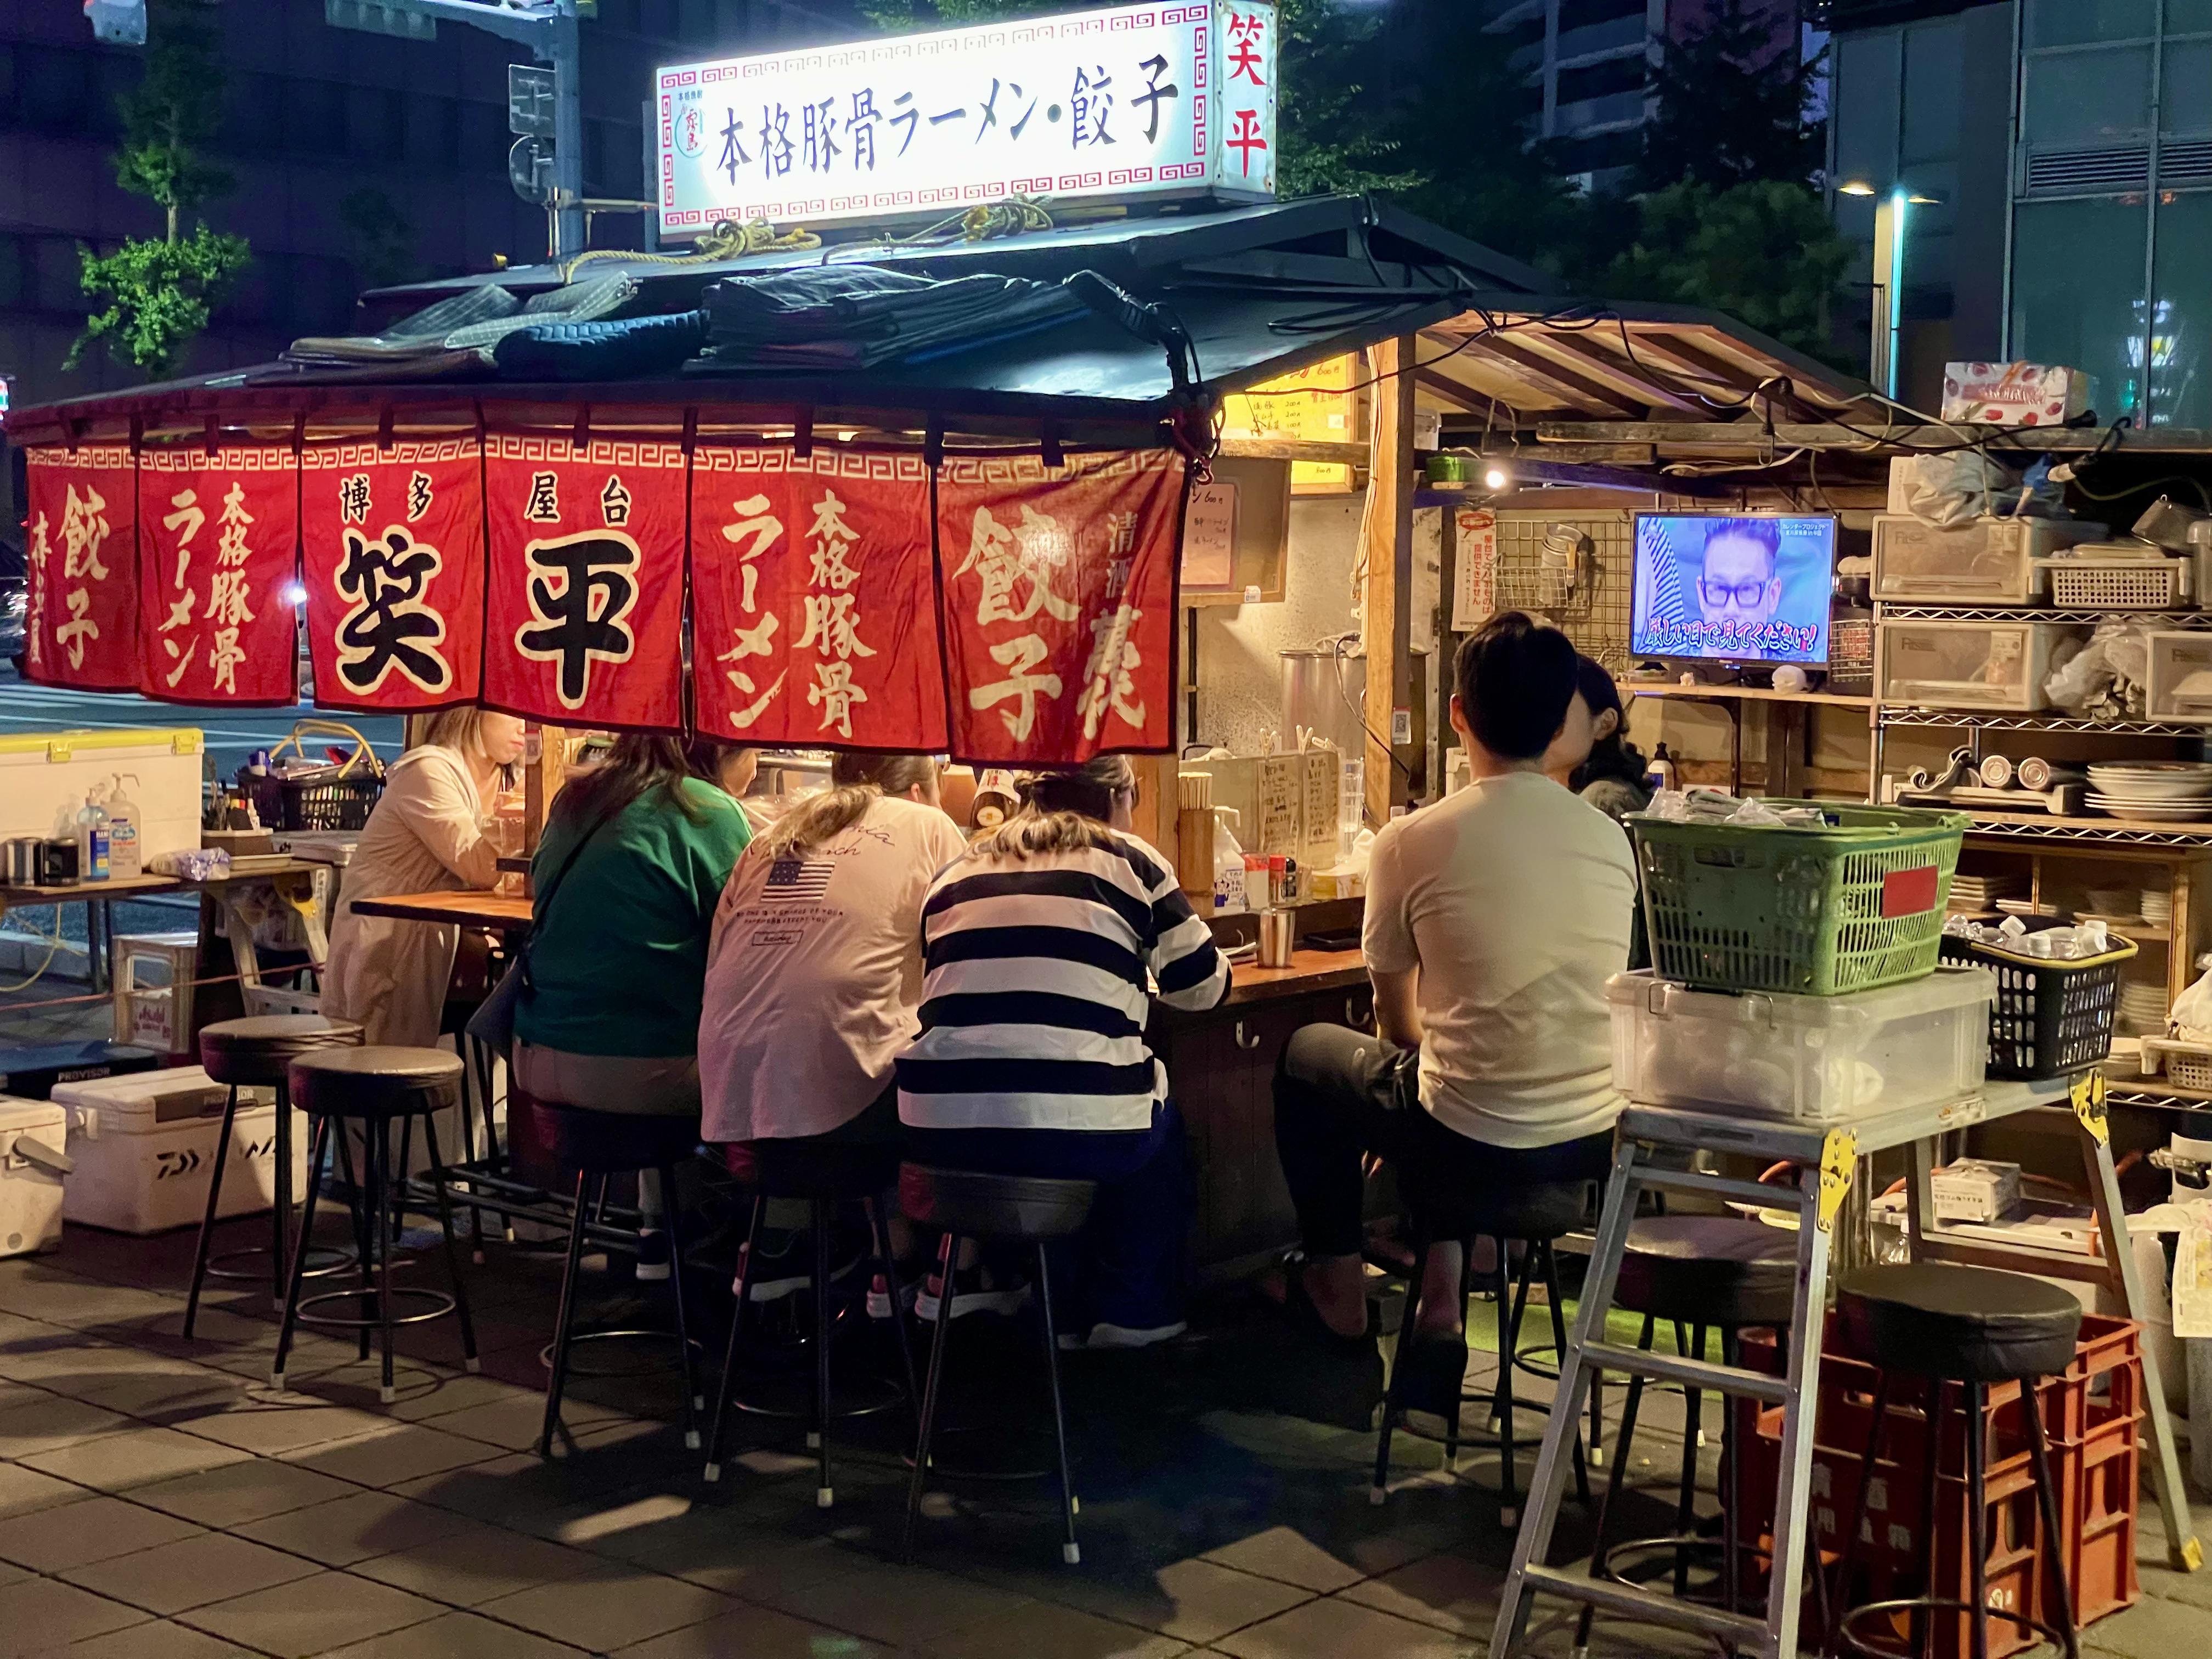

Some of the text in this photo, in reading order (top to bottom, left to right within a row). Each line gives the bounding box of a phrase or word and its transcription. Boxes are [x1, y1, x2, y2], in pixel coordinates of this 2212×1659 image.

[716, 53, 1180, 187] 本格豚骨ラーメン・餃子
[1226, 12, 1268, 179] 笑平
[56, 483, 110, 671] 餃子
[158, 488, 206, 688] ラーメン
[204, 481, 256, 695] 本格豚骨
[340, 471, 435, 525] 博多
[524, 471, 632, 527] 屋台
[717, 493, 788, 729] ラーメン
[792, 488, 878, 738] 本格豚骨
[952, 504, 1081, 743] 餃子
